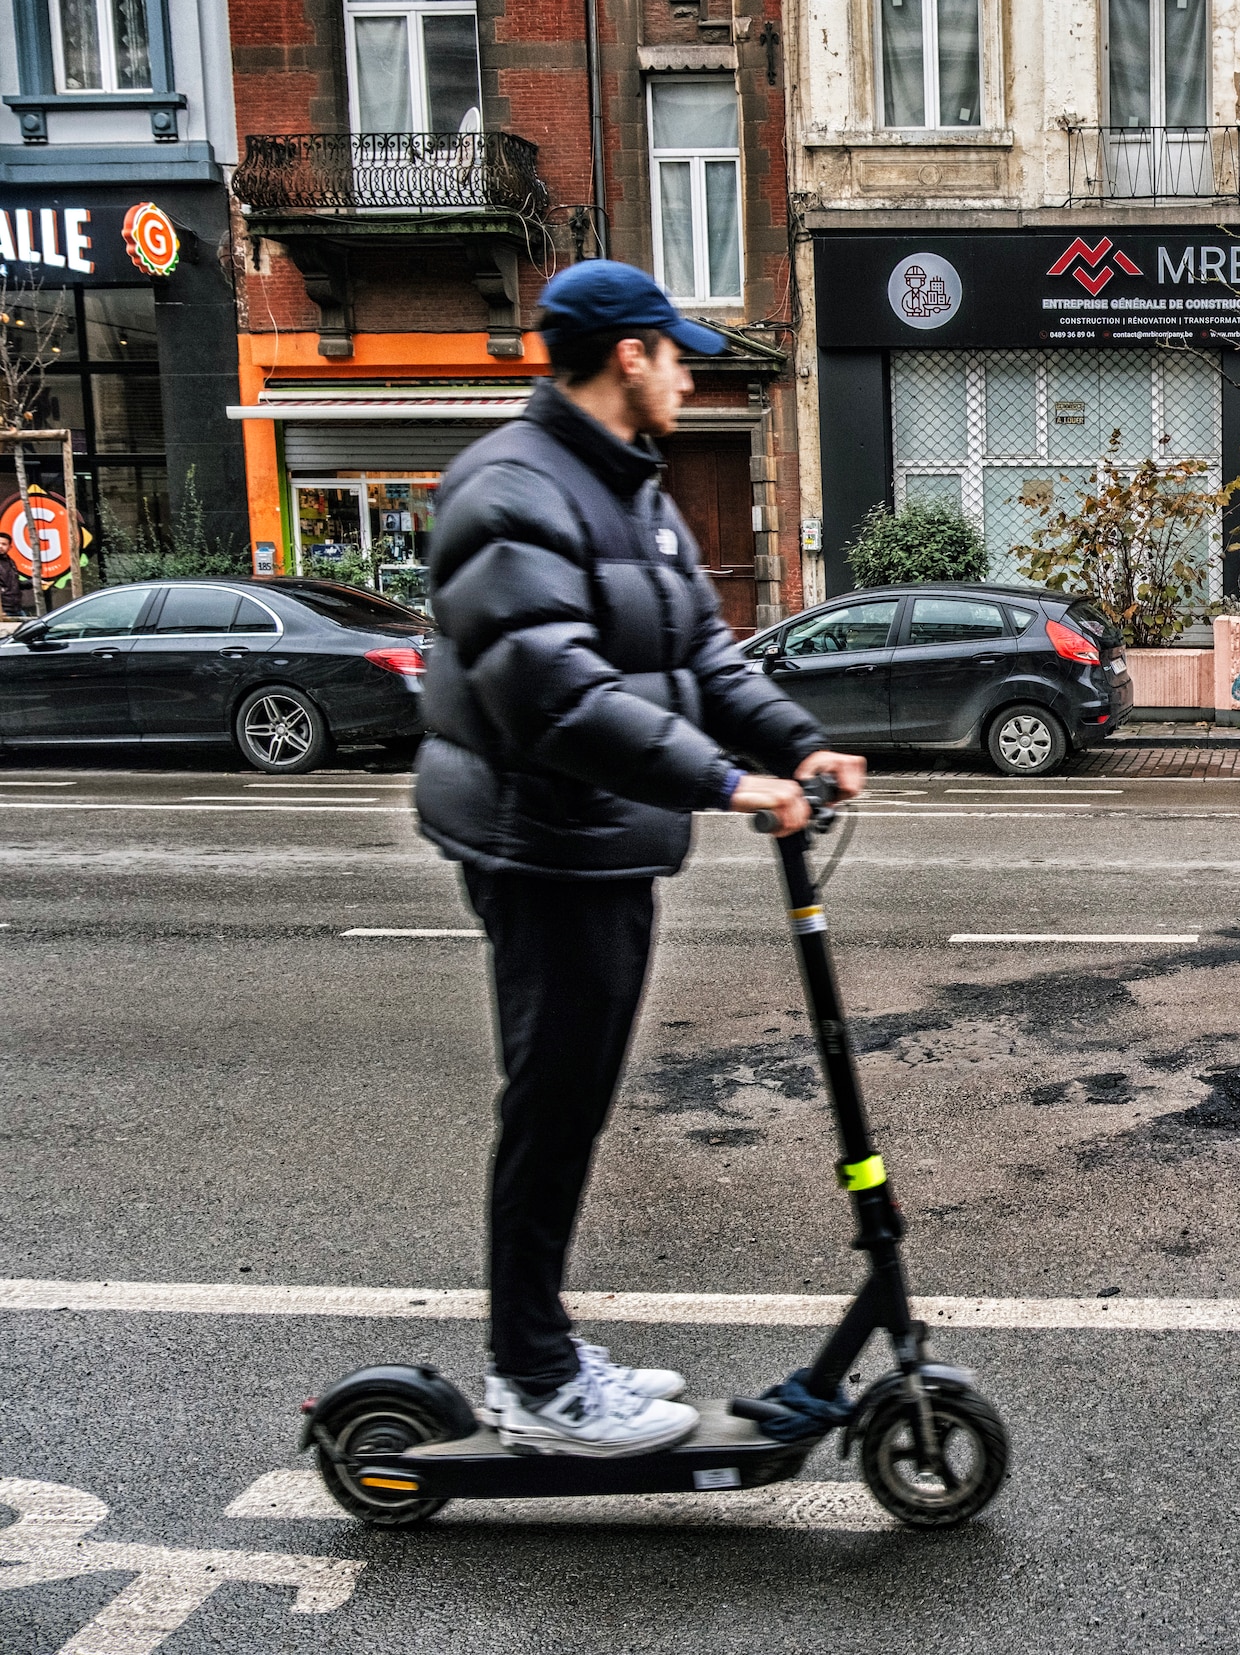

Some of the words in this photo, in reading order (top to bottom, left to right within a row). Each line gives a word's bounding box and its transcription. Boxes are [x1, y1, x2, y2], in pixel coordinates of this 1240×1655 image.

[144, 219, 167, 256] G
[1042, 298, 1109, 310] ENTREPRISE
[1110, 297, 1167, 310] GÉNÉRALE
[1168, 298, 1184, 310] DE
[1060, 316, 1120, 325] CONSTRUCTION
[1127, 315, 1177, 325] RÉNOVATION
[1049, 331, 1066, 339] 0489
[1067, 331, 1076, 339] 36
[1076, 331, 1086, 339] 89
[1086, 331, 1095, 339] 04
[12, 507, 62, 563] G
